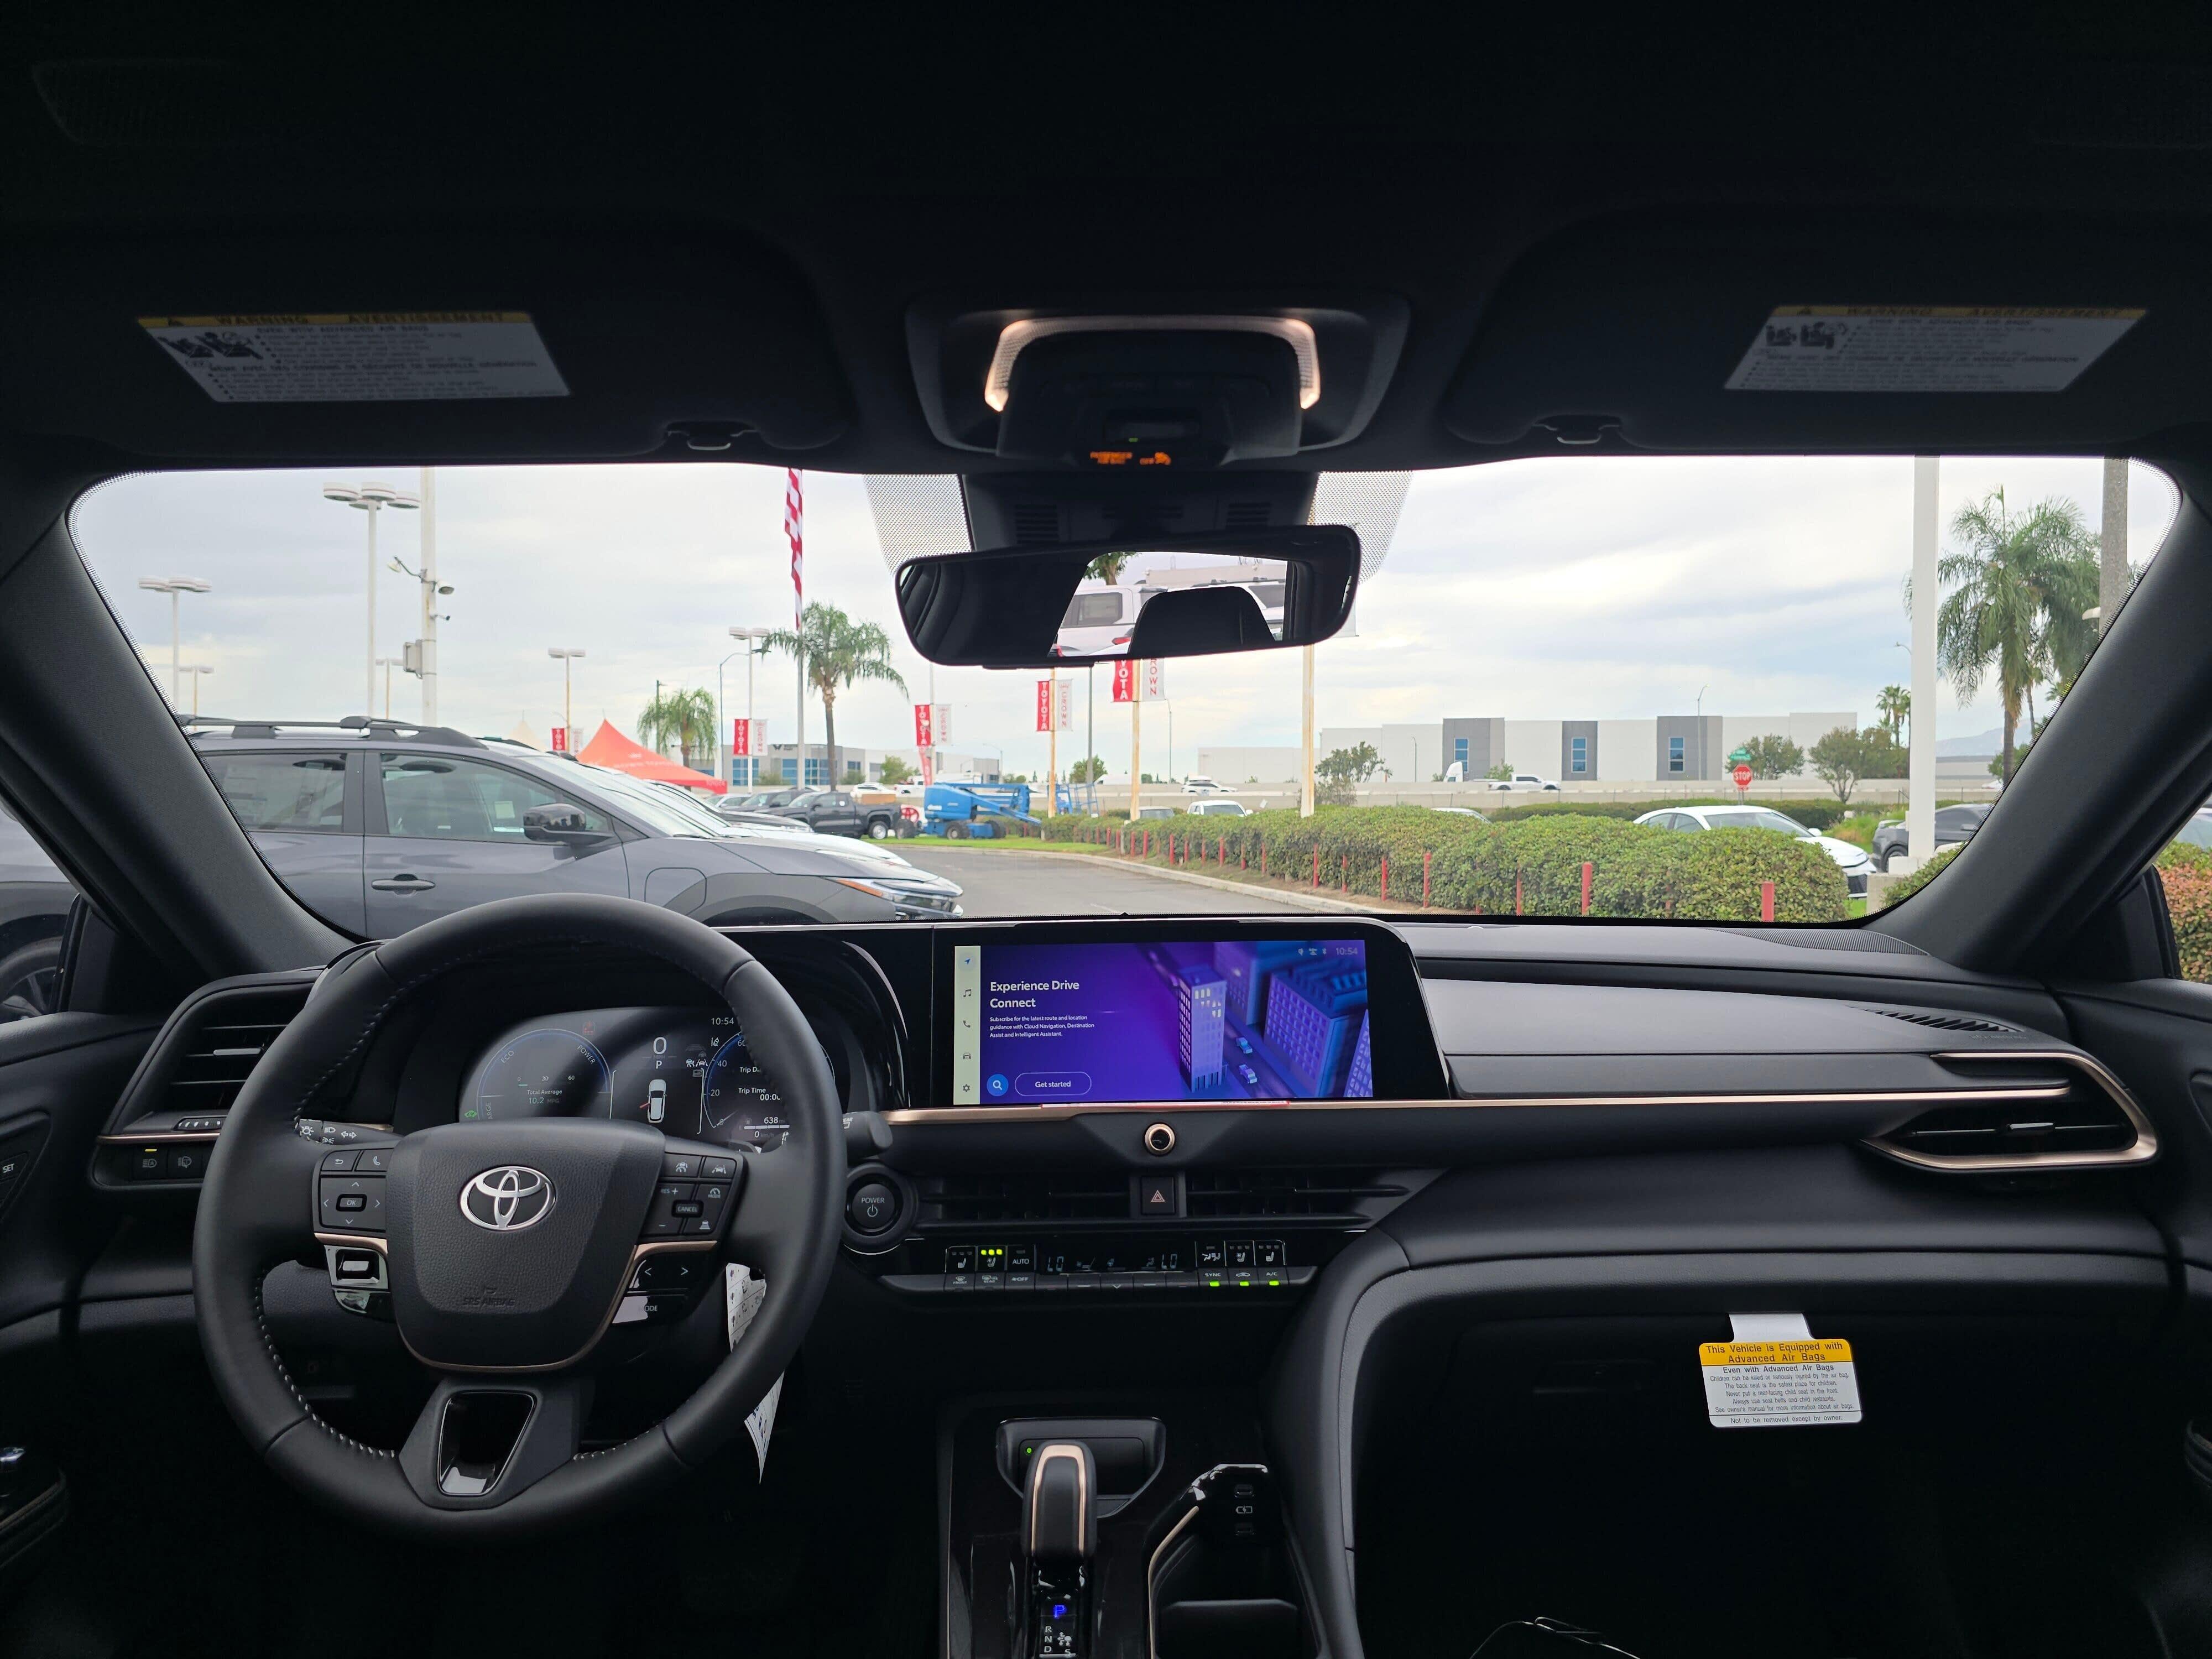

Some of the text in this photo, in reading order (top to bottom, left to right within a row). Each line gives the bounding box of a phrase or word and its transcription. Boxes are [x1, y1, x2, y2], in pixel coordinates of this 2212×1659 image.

[1119, 660, 1128, 700] YOTA
[1150, 659, 1158, 695] ROWN
[1734, 771, 1751, 780] STOP
[990, 980, 1079, 993] Experience Drive
[990, 998, 1036, 1008] Connect
[653, 1037, 667, 1054] 0
[500, 1050, 514, 1063] ECO
[577, 1045, 596, 1065] POWER
[656, 1060, 662, 1069] P
[2, 1164, 14, 1173] SET
[1730, 1344, 1761, 1353] Vehicle
[1779, 1343, 1820, 1353] Equipped
[1054, 1605, 1066, 1619] P
